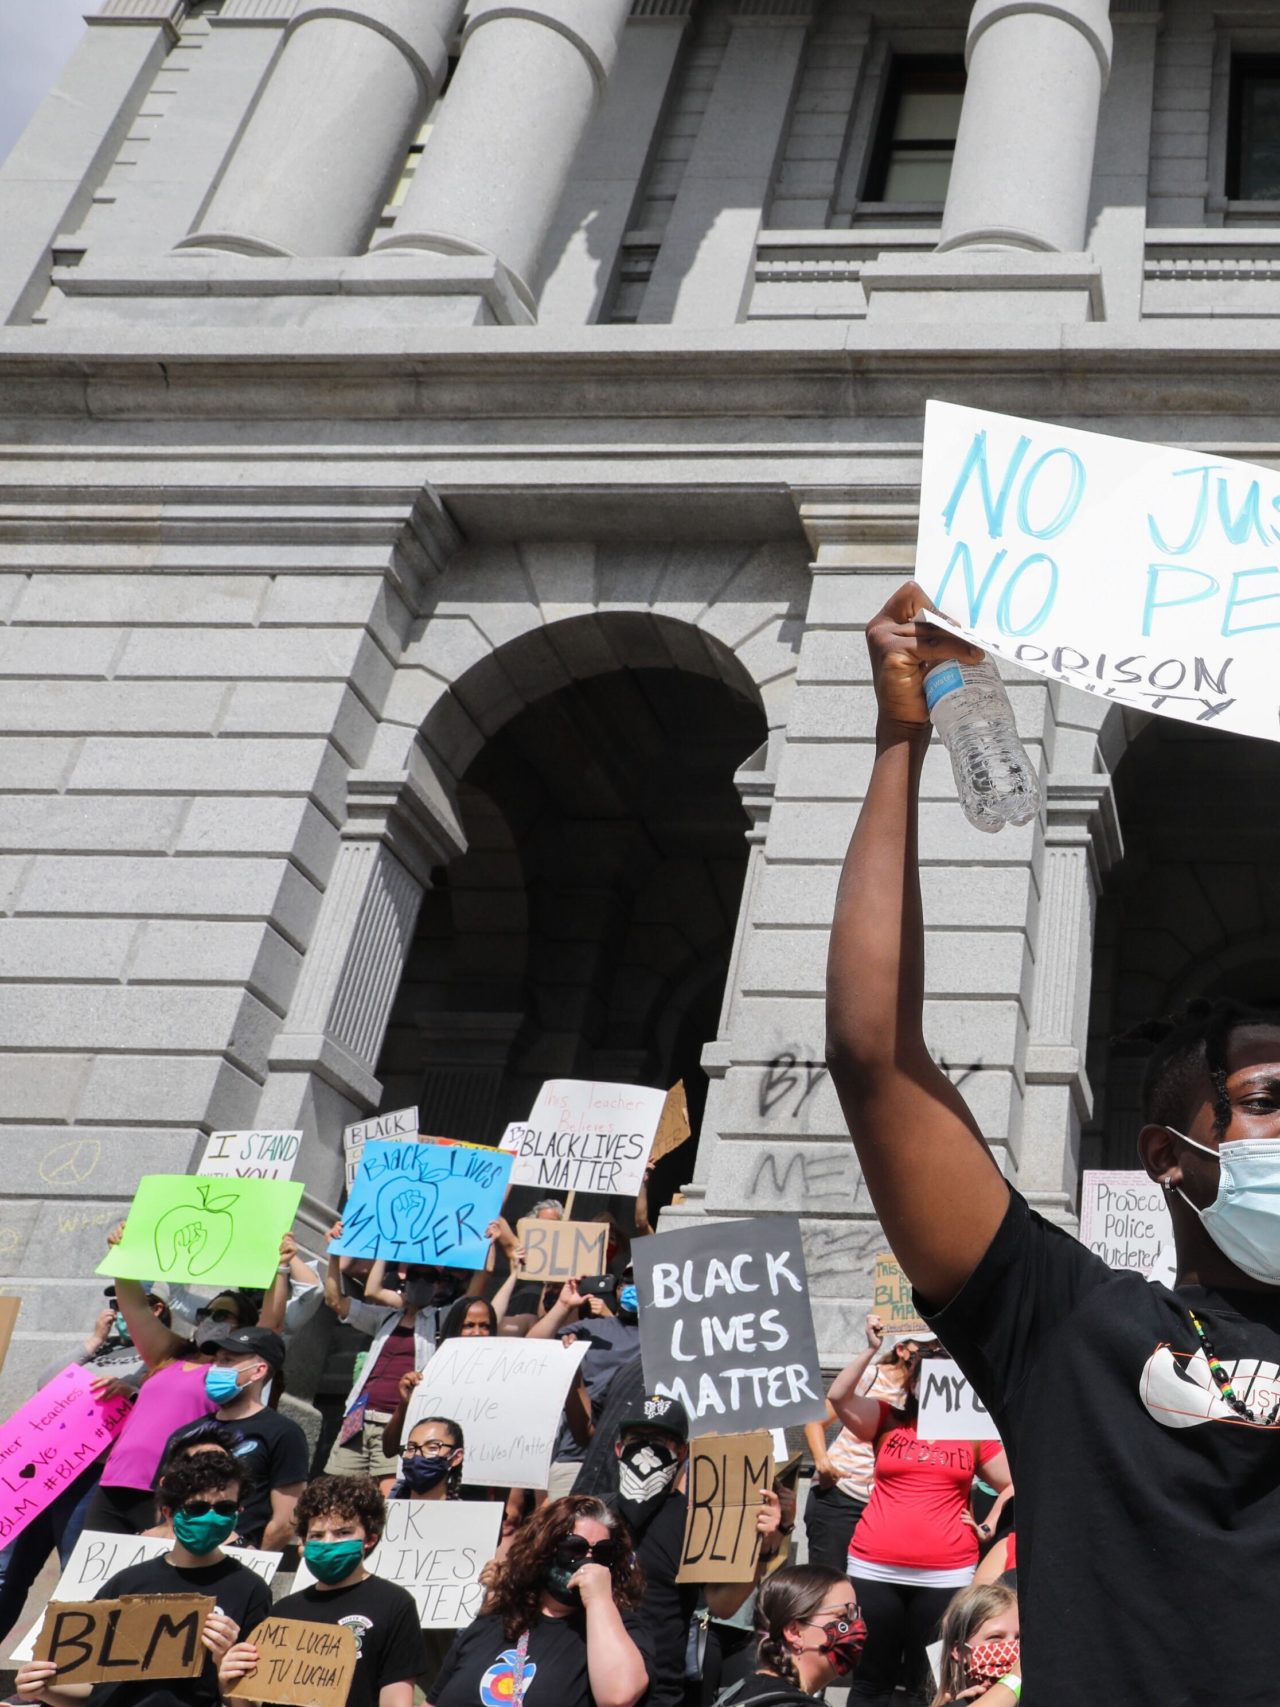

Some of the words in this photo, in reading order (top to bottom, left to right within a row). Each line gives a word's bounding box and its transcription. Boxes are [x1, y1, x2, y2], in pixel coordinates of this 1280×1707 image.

[941, 429, 1087, 541] NO
[933, 541, 1059, 638] NO
[208, 1134, 237, 1159] I
[240, 1134, 299, 1161] STAND
[352, 1115, 406, 1145] BLACK
[519, 1129, 580, 1159] BLACK
[580, 1134, 644, 1160] LIVES
[363, 1144, 428, 1182] Black
[450, 1150, 503, 1188] Lives
[538, 1158, 623, 1192] MATTER
[343, 1203, 483, 1262] MATTER
[1105, 1214, 1155, 1239] Police
[523, 1227, 606, 1278] BLM
[651, 1250, 803, 1309] BLACK
[670, 1309, 789, 1363] LIVES
[427, 1347, 491, 1387] WE
[29, 1387, 84, 1431] teaches
[654, 1363, 819, 1422] MATTER
[922, 1372, 967, 1413] MY
[95, 1401, 132, 1438] #BLM
[43, 1443, 96, 1491] #BLM
[682, 1454, 770, 1569] BLM
[47, 1609, 200, 1675] BLM
[296, 1629, 341, 1658] LUCHA
[268, 1659, 293, 1685] TU
[293, 1664, 345, 1688] LUCHA!
